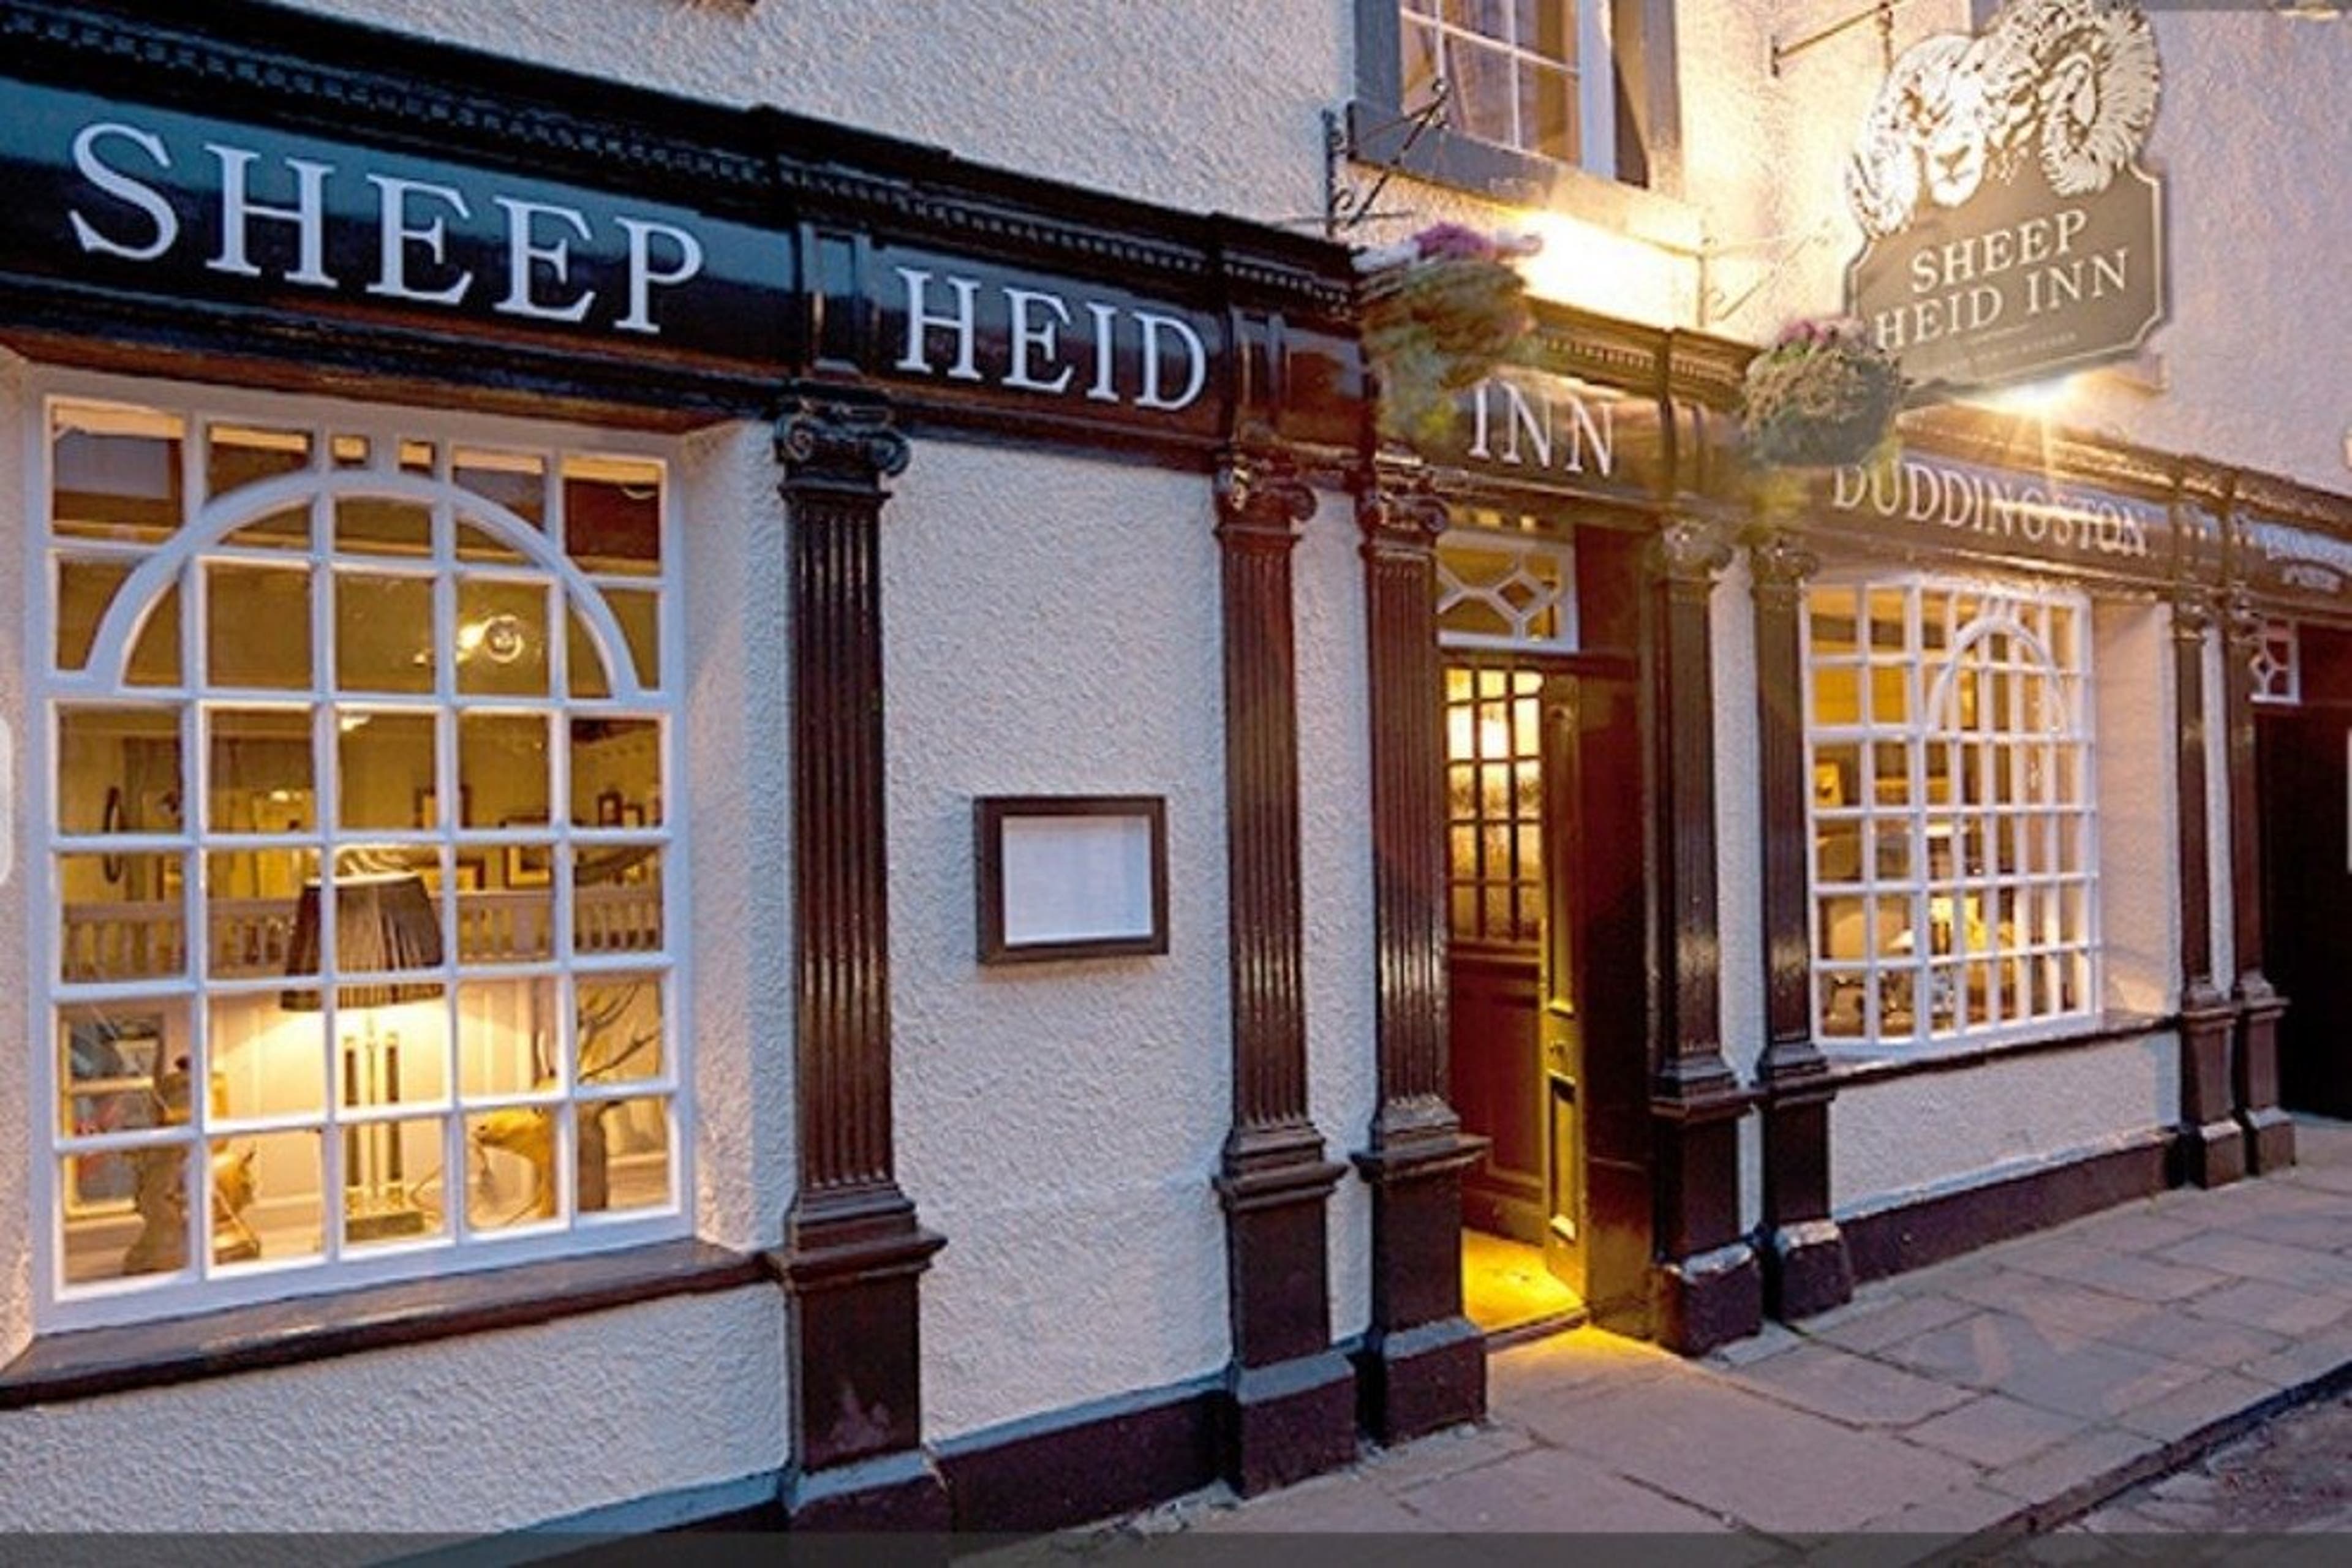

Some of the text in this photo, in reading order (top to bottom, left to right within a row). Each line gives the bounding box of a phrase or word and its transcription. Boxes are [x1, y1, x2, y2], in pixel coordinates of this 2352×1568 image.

[67, 123, 1612, 477] SHEEP HEID INN
[1874, 247, 2130, 350] HEID INN
[1911, 209, 2087, 293] SHEEP
